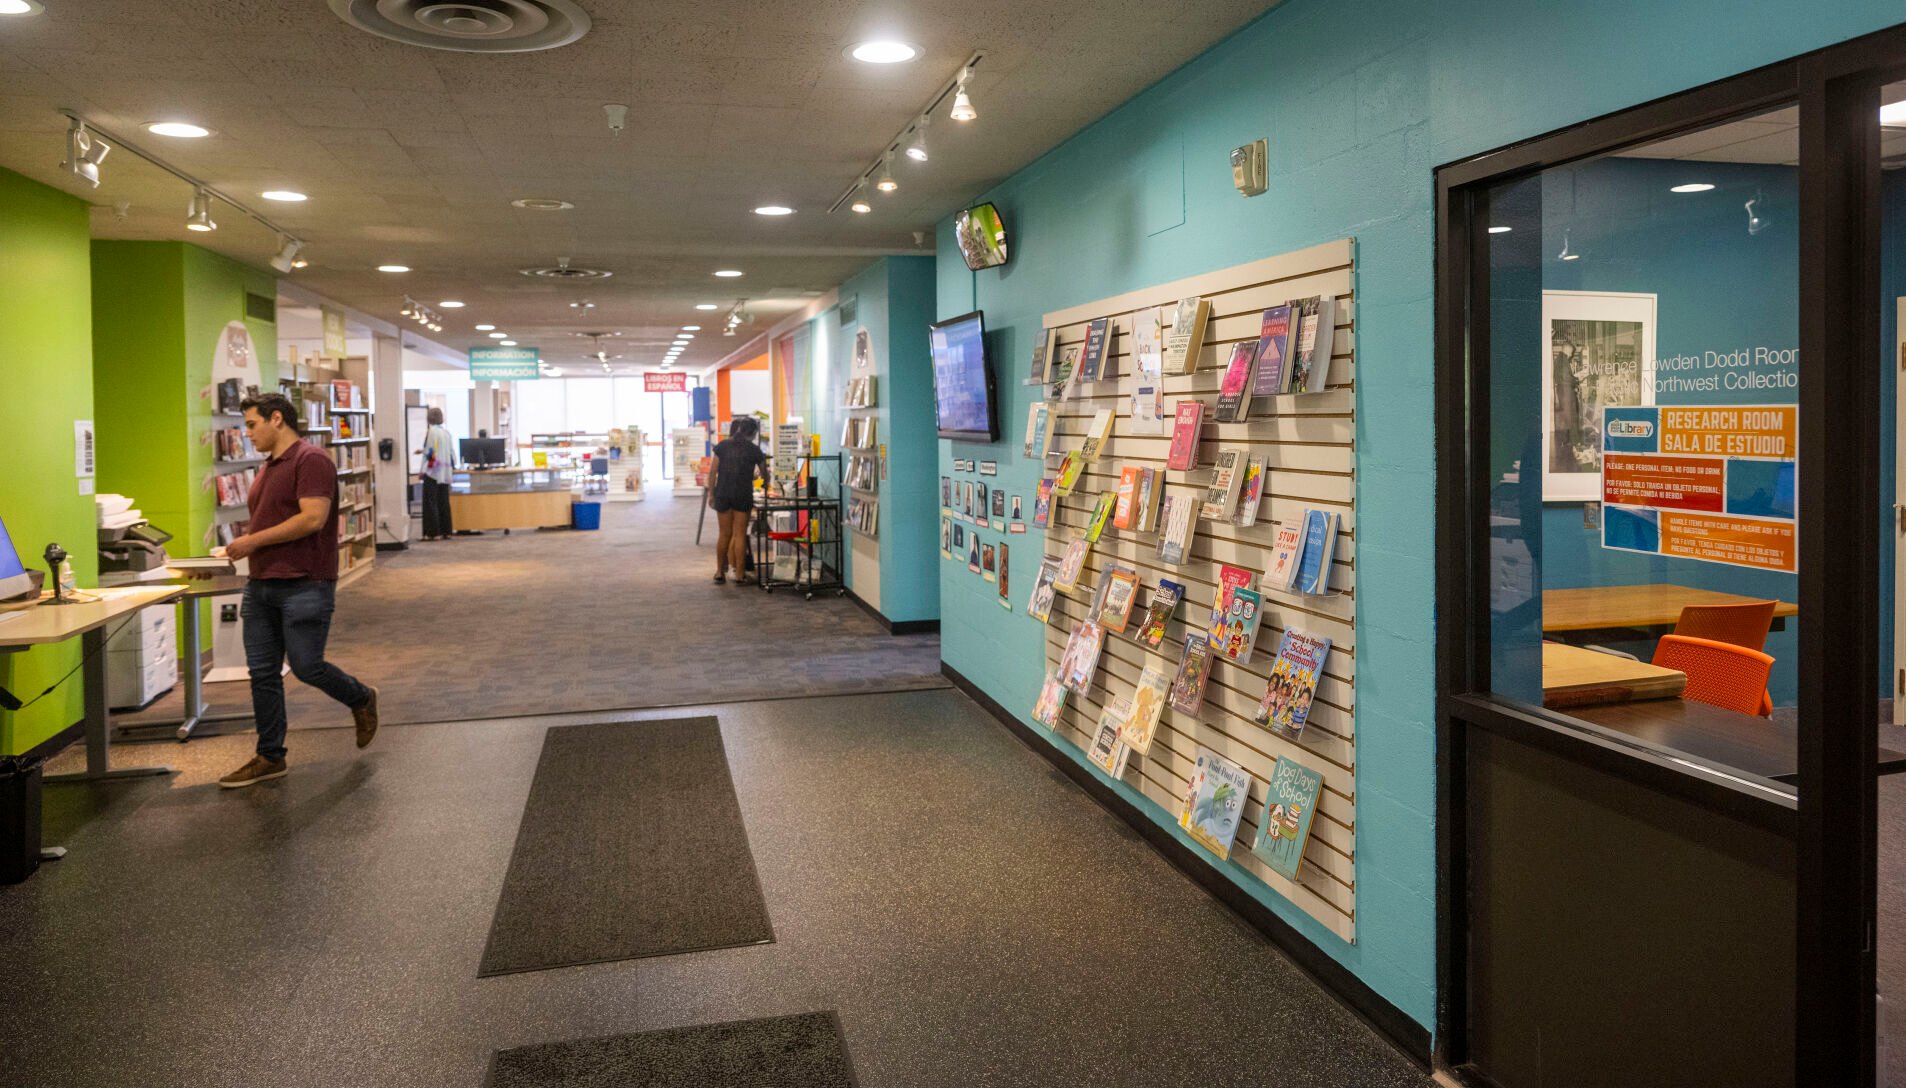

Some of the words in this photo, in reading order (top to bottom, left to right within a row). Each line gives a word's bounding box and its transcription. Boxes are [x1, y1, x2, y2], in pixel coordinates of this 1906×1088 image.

[1263, 317, 1288, 326] LEARNING
[1262, 326, 1286, 335] AMERICA
[472, 351, 535, 359] INFORMATION
[1704, 349, 1750, 369] Dodd
[472, 366, 537, 377] INFORMACIÓN
[645, 375, 672, 383] LIBROS
[1643, 374, 1720, 393] Northwest
[1724, 369, 1799, 390] Collectio
[647, 382, 682, 391] ESPAÑOL
[1667, 411, 1738, 430] RESEARCH
[1742, 411, 1784, 431] ROOM
[1619, 422, 1652, 436] Library
[1665, 434, 1700, 451] SALA
[1705, 434, 1722, 452] DE
[1727, 435, 1785, 454] ESTUDIO
[1625, 463, 1635, 471] ONE
[1635, 464, 1659, 472] PERSONAL
[1675, 466, 1682, 474] NO
[1683, 466, 1696, 474] FOOD
[1705, 468, 1721, 476] DRINK
[1606, 479, 1615, 487] POR
[1633, 481, 1645, 489] SOLO
[1672, 483, 1692, 492] OBJETO
[1619, 488, 1640, 497] PERMITE
[1640, 490, 1658, 498] COMIDA
[1665, 491, 1684, 500] BEBIDA
[1716, 522, 1729, 530] CARE
[1741, 524, 1761, 533] PLEASE
[1761, 526, 1773, 535] ASK
[1773, 527, 1779, 535] IF
[1779, 528, 1792, 536] YOU
[1278, 531, 1298, 543] STUDY
[1671, 537, 1680, 545] POR
[1290, 641, 1315, 657] School
[1280, 648, 1317, 671] Community
[1277, 759, 1297, 783] Dog
[1294, 767, 1316, 792] Days
[1279, 780, 1313, 809] School
